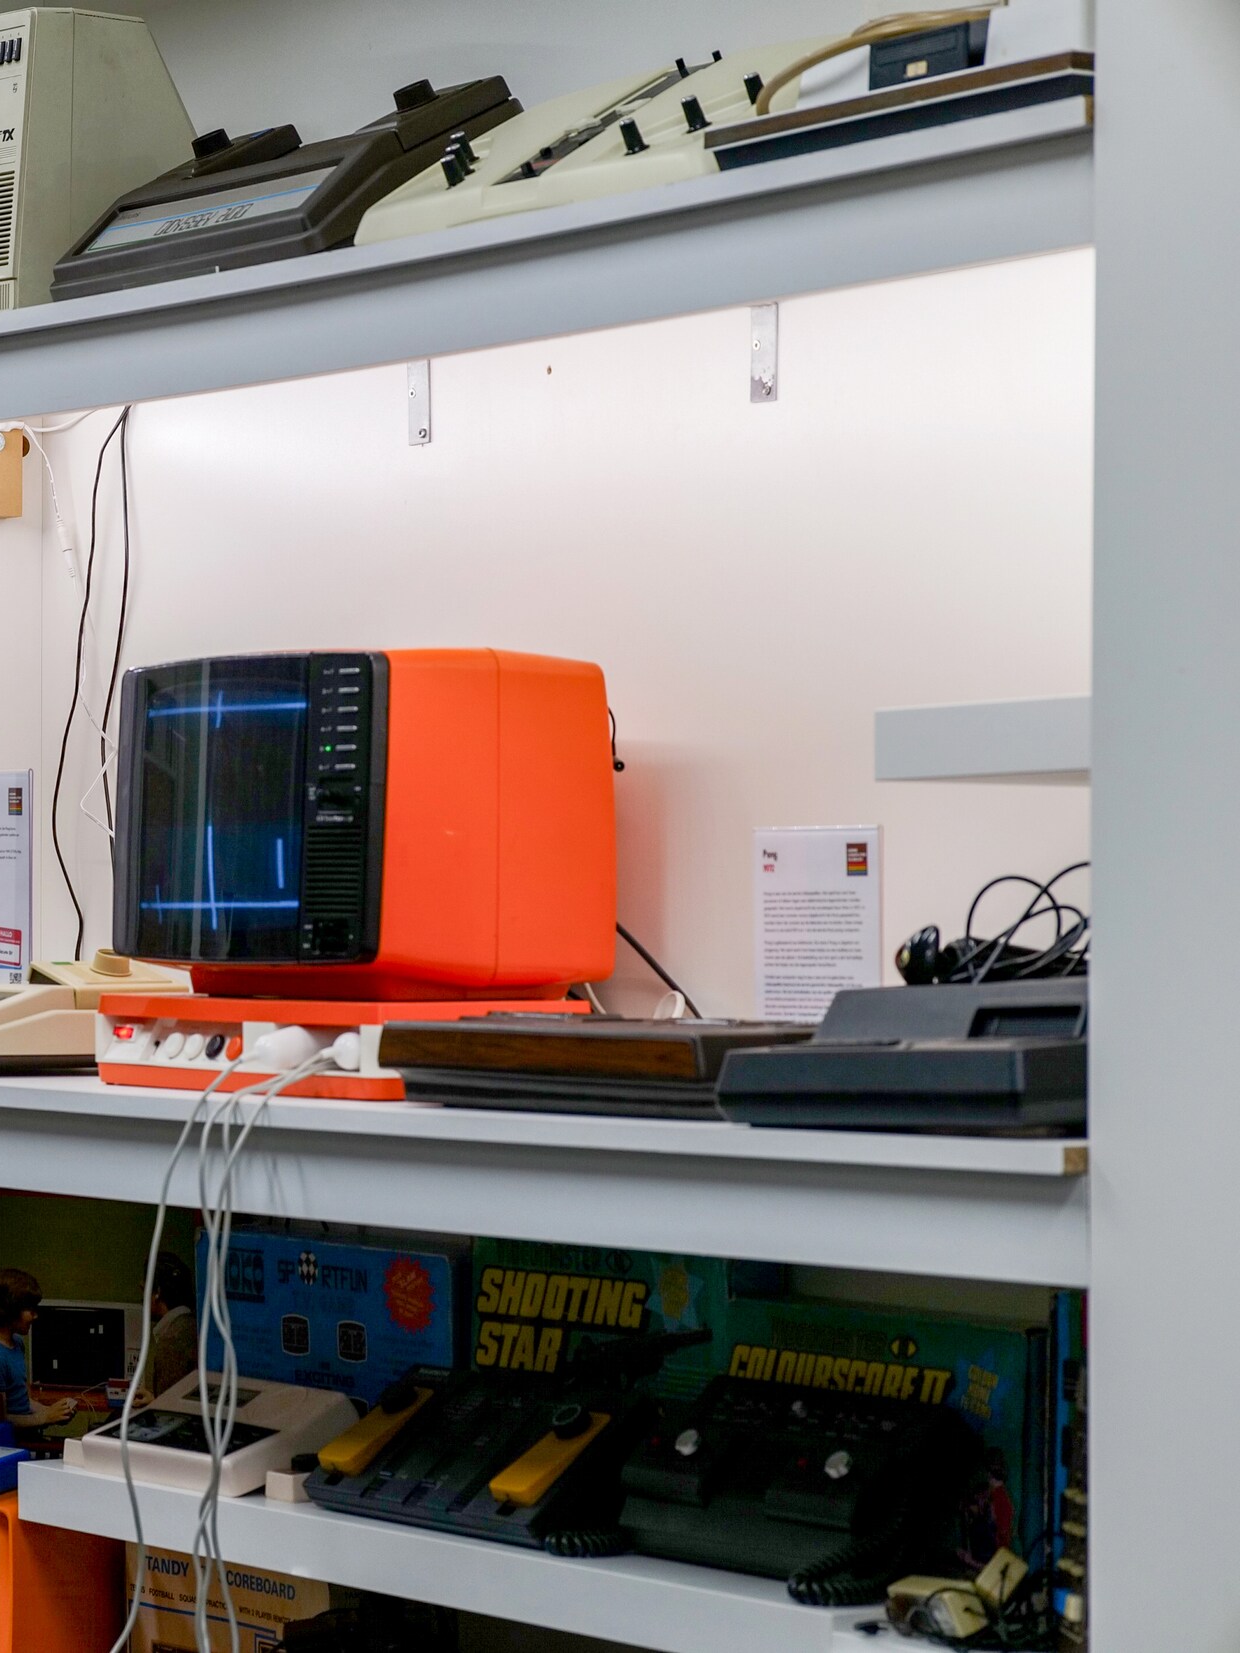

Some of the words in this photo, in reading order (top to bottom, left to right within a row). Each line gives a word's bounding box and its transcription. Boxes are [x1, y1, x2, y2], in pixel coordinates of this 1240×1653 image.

[2, 128, 15, 142] TX
[763, 849, 777, 861] Pong
[476, 1267, 648, 1329] SHOOTING
[475, 1320, 563, 1374] STAR
[294, 1369, 355, 1388] EXCITING
[145, 1556, 189, 1577] TANDY
[218, 1566, 296, 1600] COREBOARD
[149, 1587, 175, 1600] FOOTBALL
[206, 1598, 227, 1611] PRACTIC
[255, 1609, 272, 1619] PLAYER
